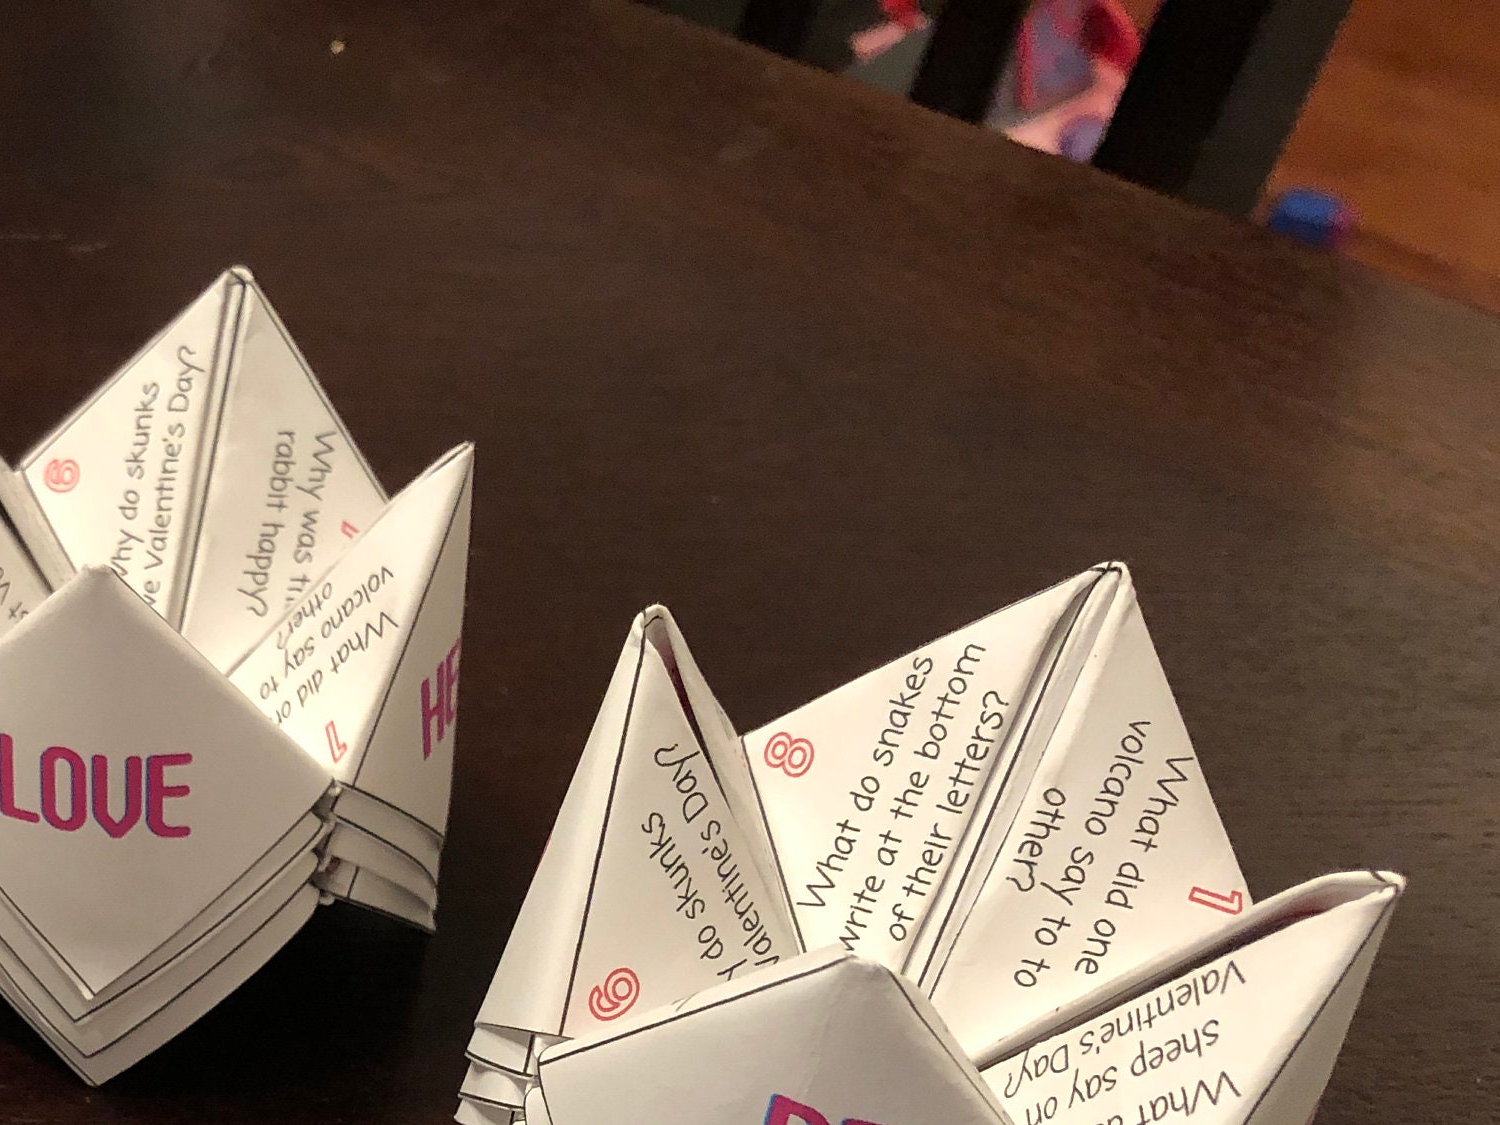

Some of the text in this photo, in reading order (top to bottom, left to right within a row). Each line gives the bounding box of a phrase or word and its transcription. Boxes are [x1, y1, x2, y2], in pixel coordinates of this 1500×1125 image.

[124, 381, 160, 481] skunks
[296, 430, 337, 502] Why
[43, 458, 81, 494] 6
[118, 489, 140, 520] do
[144, 421, 187, 570] Valentine's
[237, 429, 296, 618] rabbit happy?
[293, 509, 320, 565] was
[143, 580, 161, 605] ve
[277, 582, 333, 650] other?
[321, 566, 394, 639] volcano
[259, 675, 279, 700] to
[274, 611, 399, 726] What did on
[283, 636, 315, 679] say
[764, 732, 814, 778] 8
[796, 656, 933, 907] What do snakes
[839, 644, 987, 950] write at the bottom
[889, 690, 1010, 941] of their letters?
[1006, 787, 1066, 892] other?
[1014, 721, 1151, 987] volcano say to to
[1074, 757, 1194, 975] What did one
[641, 811, 724, 960] do skunks
[589, 967, 640, 1021] 6
[1003, 960, 1246, 1099] Valentine's Day?
[1130, 1018, 1220, 1077] sheep
[1068, 1065, 1118, 1109] say
